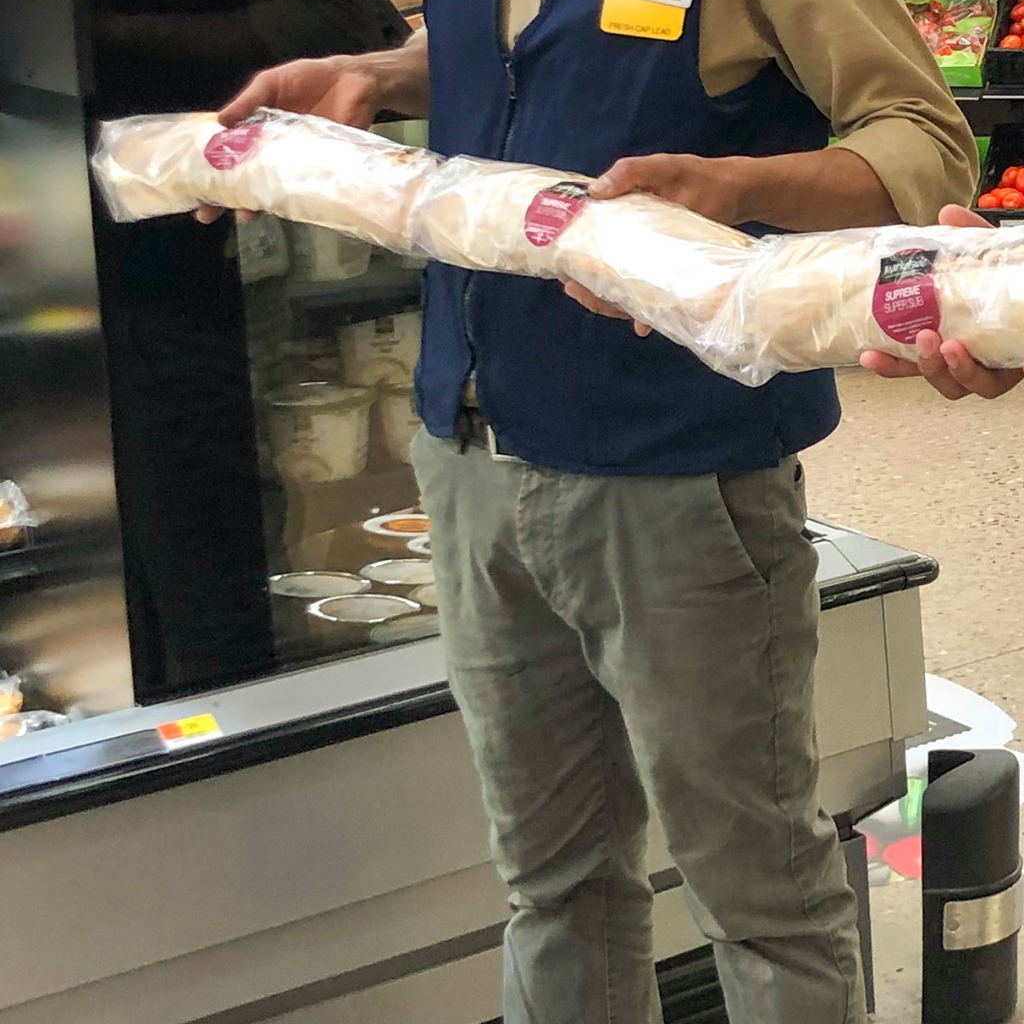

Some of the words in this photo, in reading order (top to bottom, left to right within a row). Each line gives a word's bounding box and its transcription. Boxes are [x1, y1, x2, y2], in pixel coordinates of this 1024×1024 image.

[609, 22, 634, 32] FRESH
[635, 24, 652, 33] CAP
[652, 26, 671, 36] LEAD
[884, 284, 921, 302] SUPREME
[883, 298, 908, 314] SUPER
[907, 295, 925, 308] SUB
